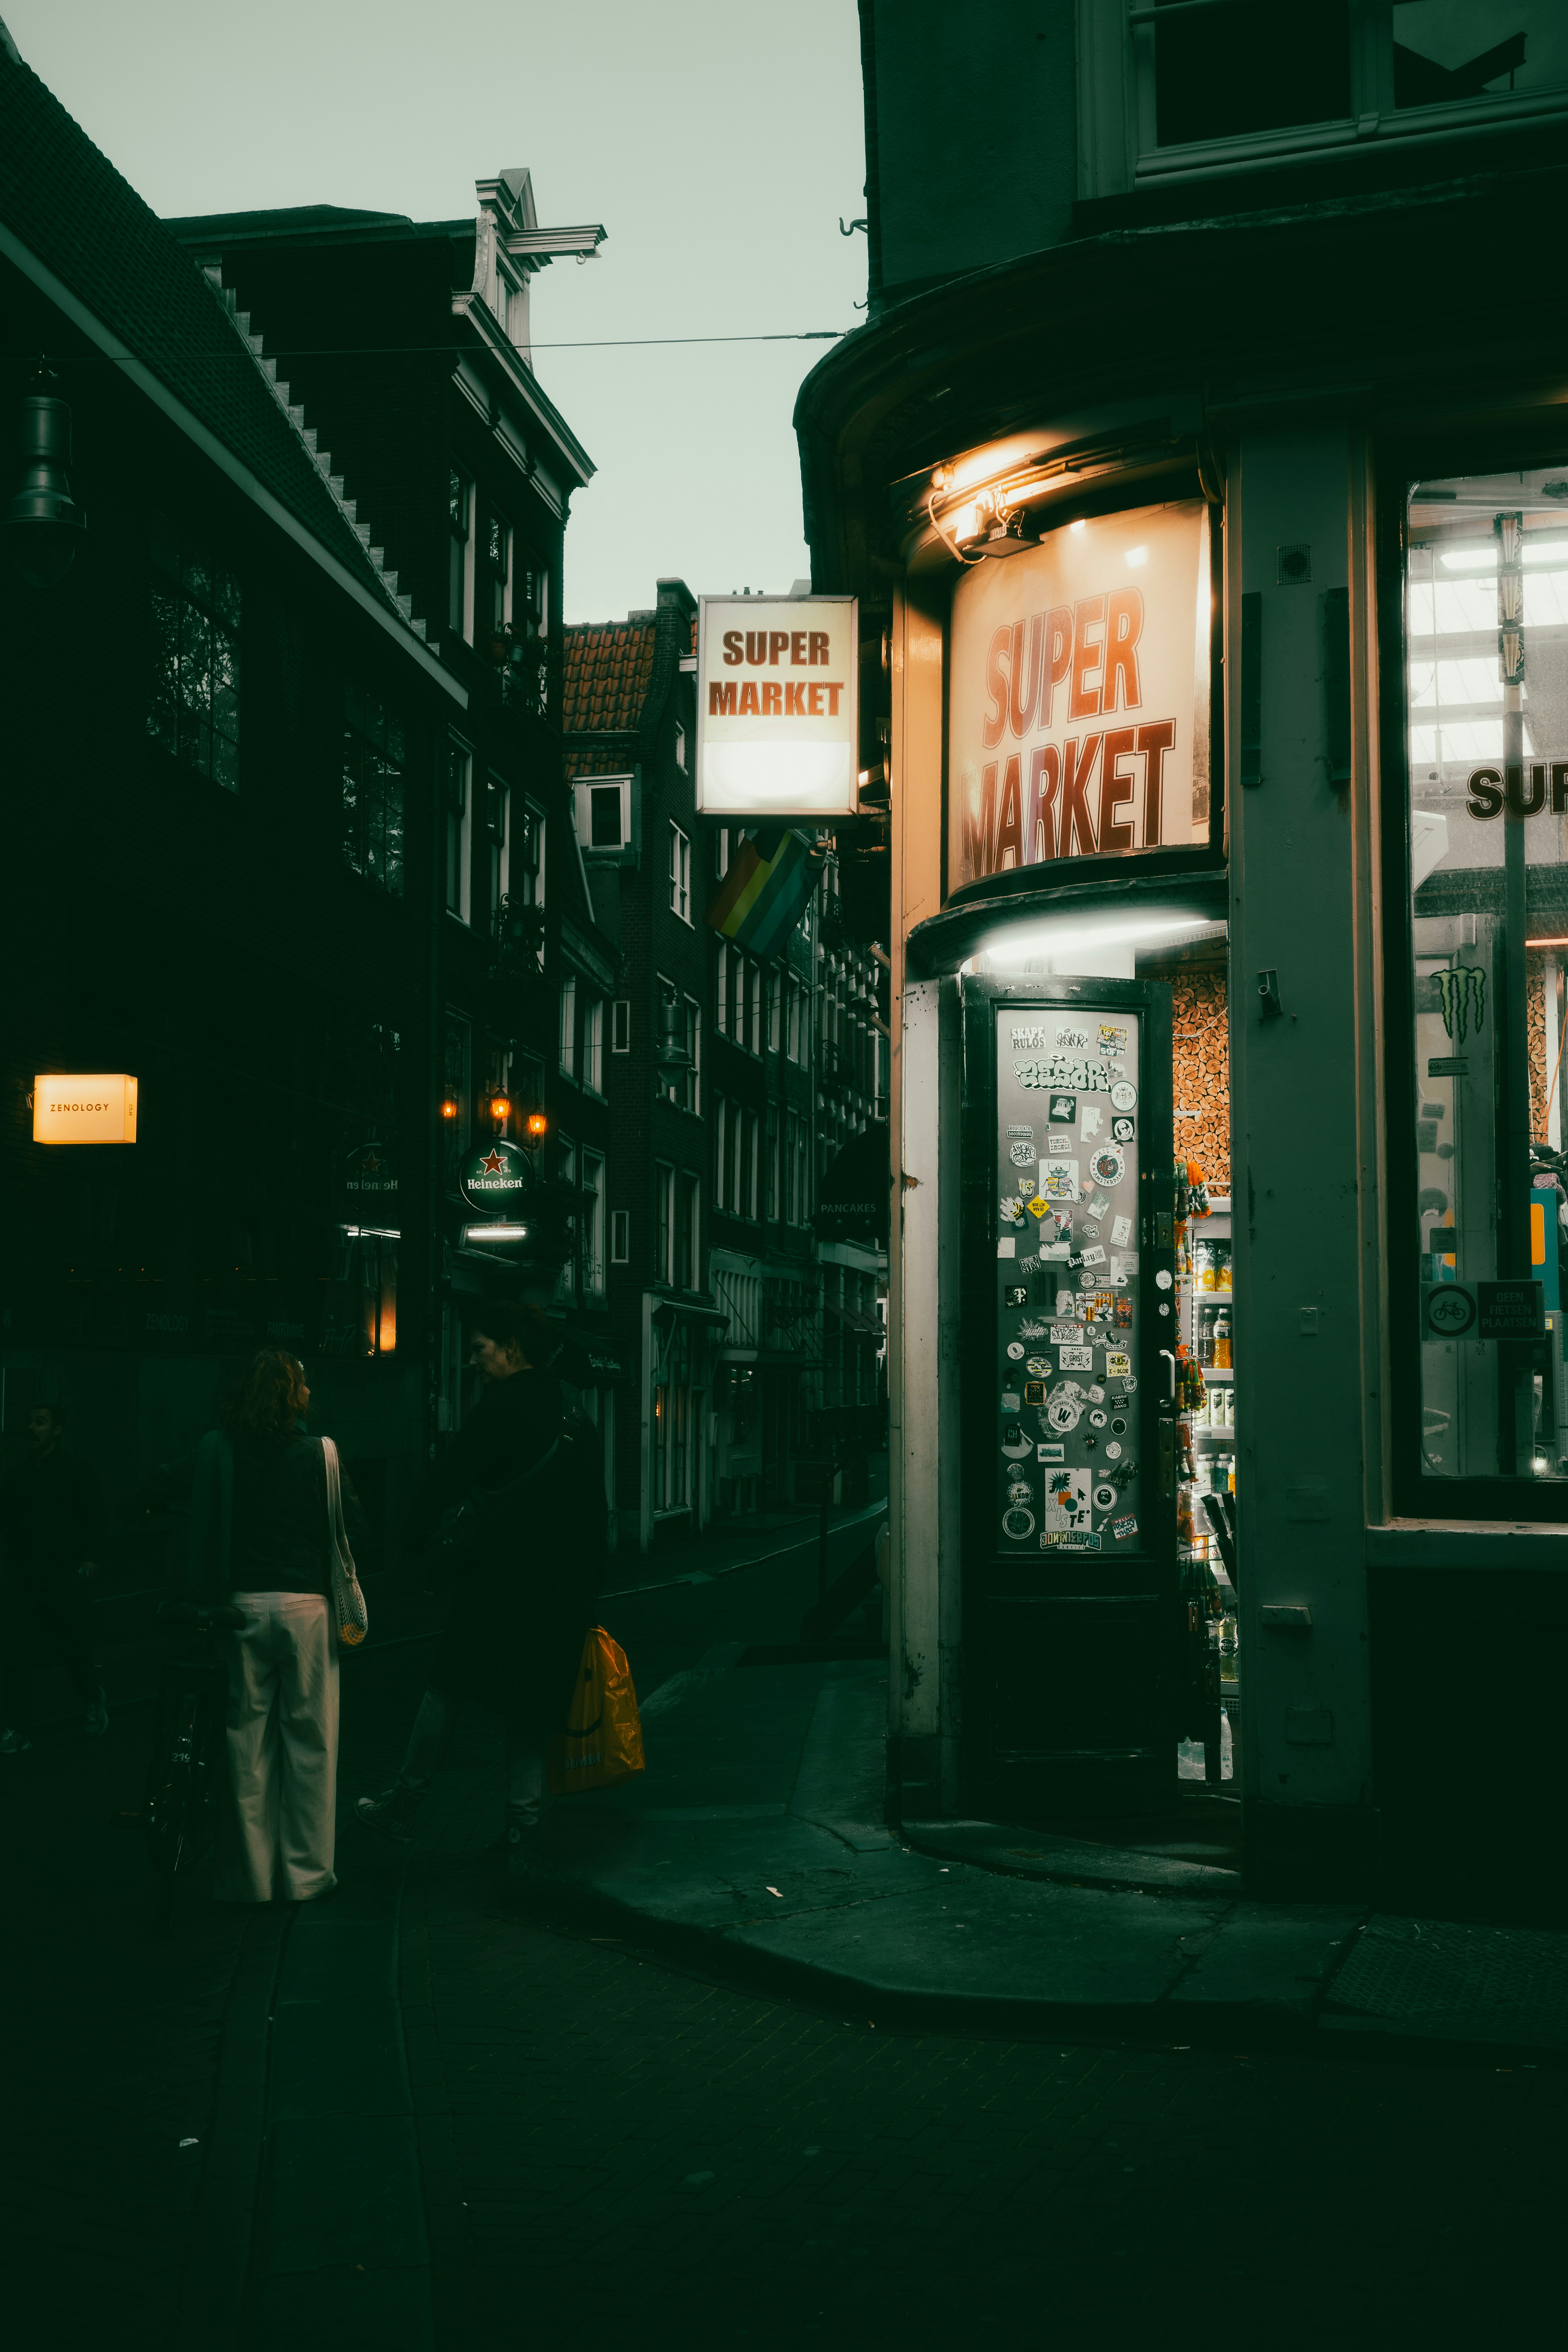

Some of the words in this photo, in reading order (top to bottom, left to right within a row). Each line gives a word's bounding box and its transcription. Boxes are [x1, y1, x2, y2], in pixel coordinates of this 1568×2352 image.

[722, 630, 830, 666] SUPER
[983, 586, 1145, 750] SUPER
[709, 681, 844, 717] MARKET
[961, 717, 1177, 882] MARKET
[1011, 1026, 1044, 1039] SKAPE
[1013, 1037, 1044, 1049] RULOS
[50, 1103, 109, 1112] ZENOLOGY
[468, 1178, 523, 1189] Heineken
[1093, 1172, 1123, 1185] AMSTERDAM
[821, 1203, 876, 1213] PANCAKES
[1067, 1253, 1096, 1268] Parlay
[1497, 1292, 1524, 1302] GEEN
[1490, 1305, 1531, 1315] FIETSEN
[146, 1312, 190, 1333] ZENOLOGY
[1482, 1317, 1536, 1328] PLAATSEN
[267, 1321, 305, 1339] PANTOMIME
[1053, 1401, 1069, 1409] WITTORFER
[1069, 1404, 1077, 1419] BRAUEREI
[1058, 1408, 1072, 1423] W
[1052, 1418, 1069, 1428] NEUMÜNSTER
[564, 1751, 603, 1770] JUMBO
